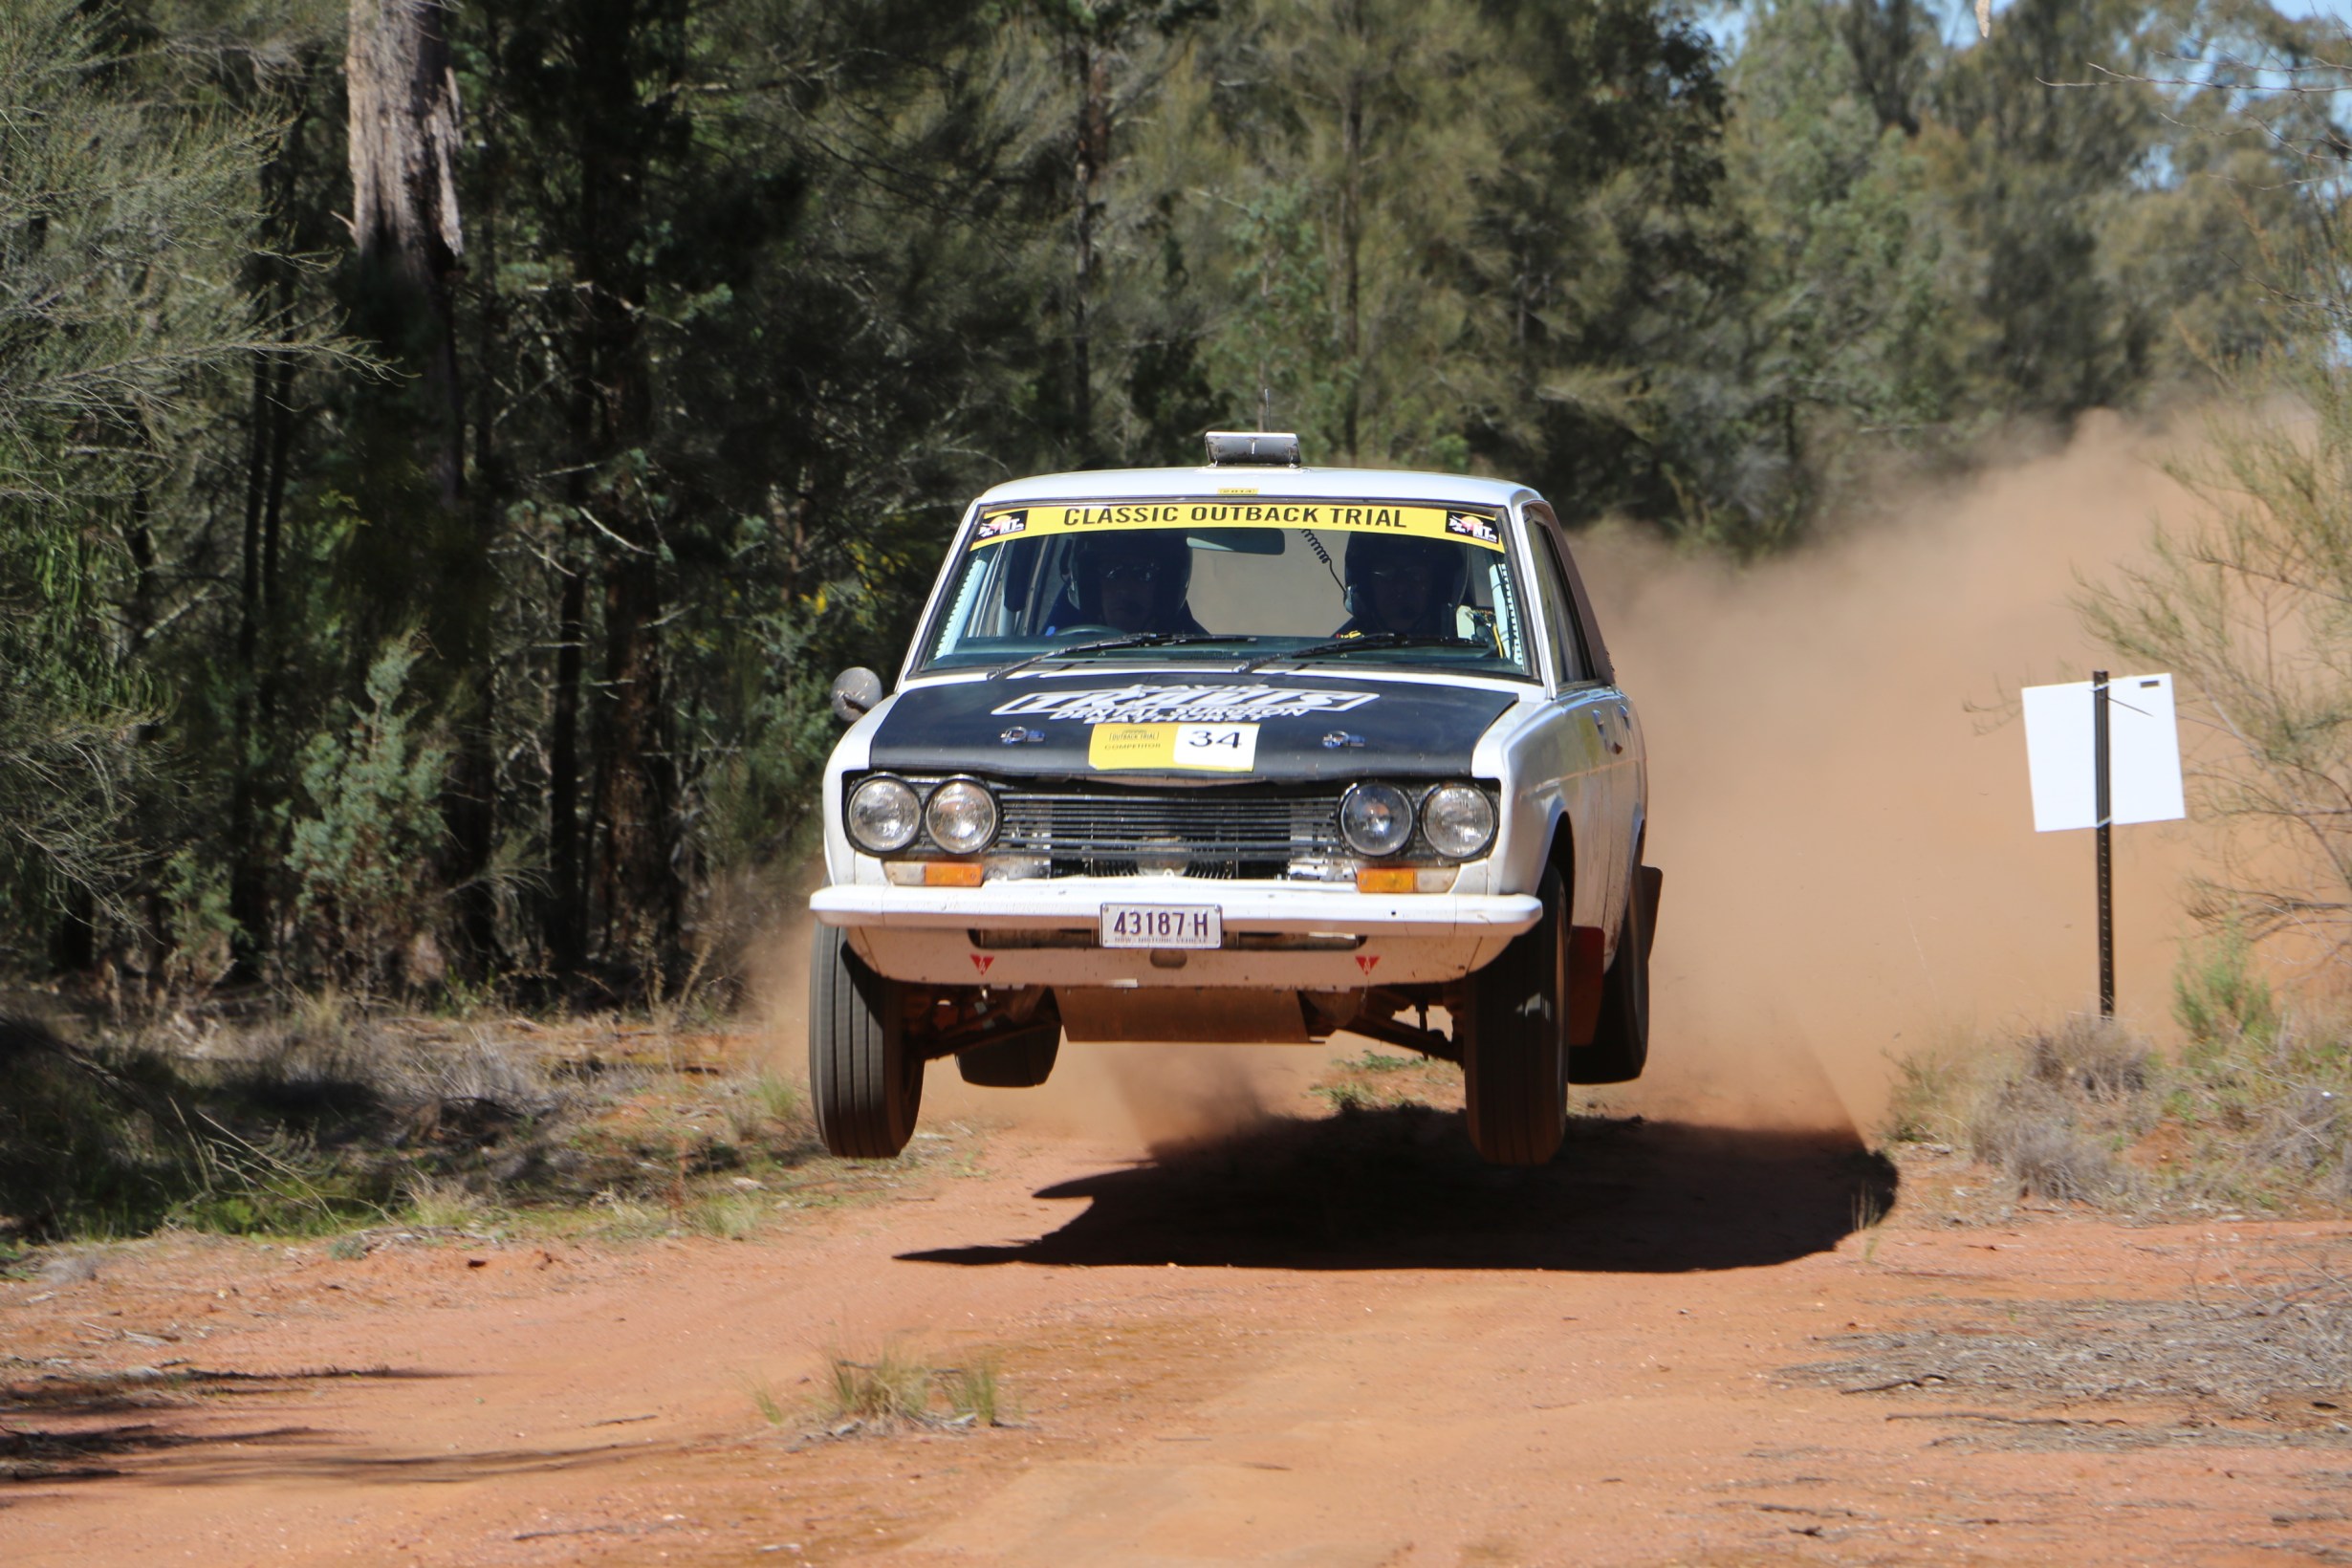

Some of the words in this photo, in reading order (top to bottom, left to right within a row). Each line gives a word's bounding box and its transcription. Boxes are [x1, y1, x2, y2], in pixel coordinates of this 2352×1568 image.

[1063, 507, 1179, 526] CLASSIC
[1190, 506, 1319, 523] OUTBACK
[1330, 508, 1407, 529] TRIAL
[1017, 689, 1365, 711] TRAVIS
[1048, 708, 1164, 721] DENTAL
[1188, 730, 1242, 749] 34
